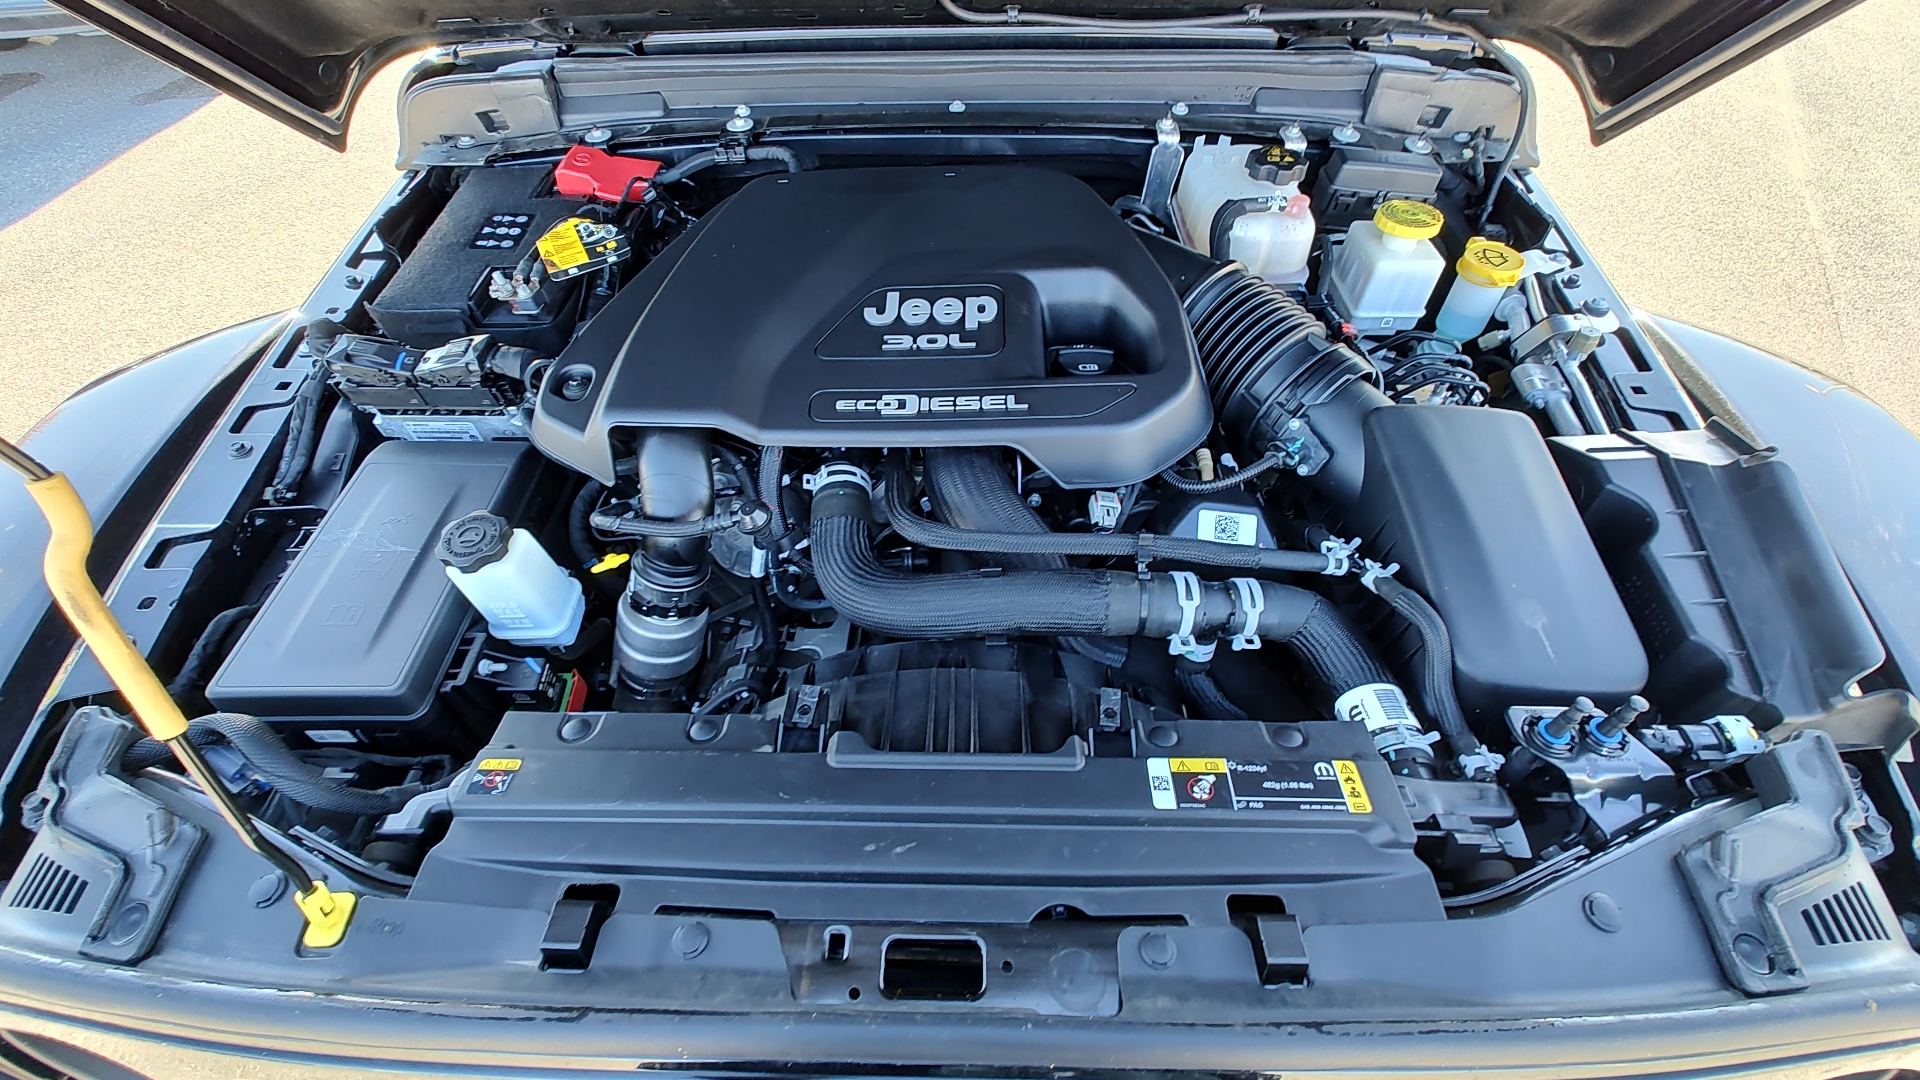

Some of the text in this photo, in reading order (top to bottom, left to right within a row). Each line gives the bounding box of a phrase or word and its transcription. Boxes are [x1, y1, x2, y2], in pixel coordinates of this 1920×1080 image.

[863, 291, 998, 331] Jeep
[881, 333, 977, 350] 3.0L
[1248, 801, 1265, 809] PAG
